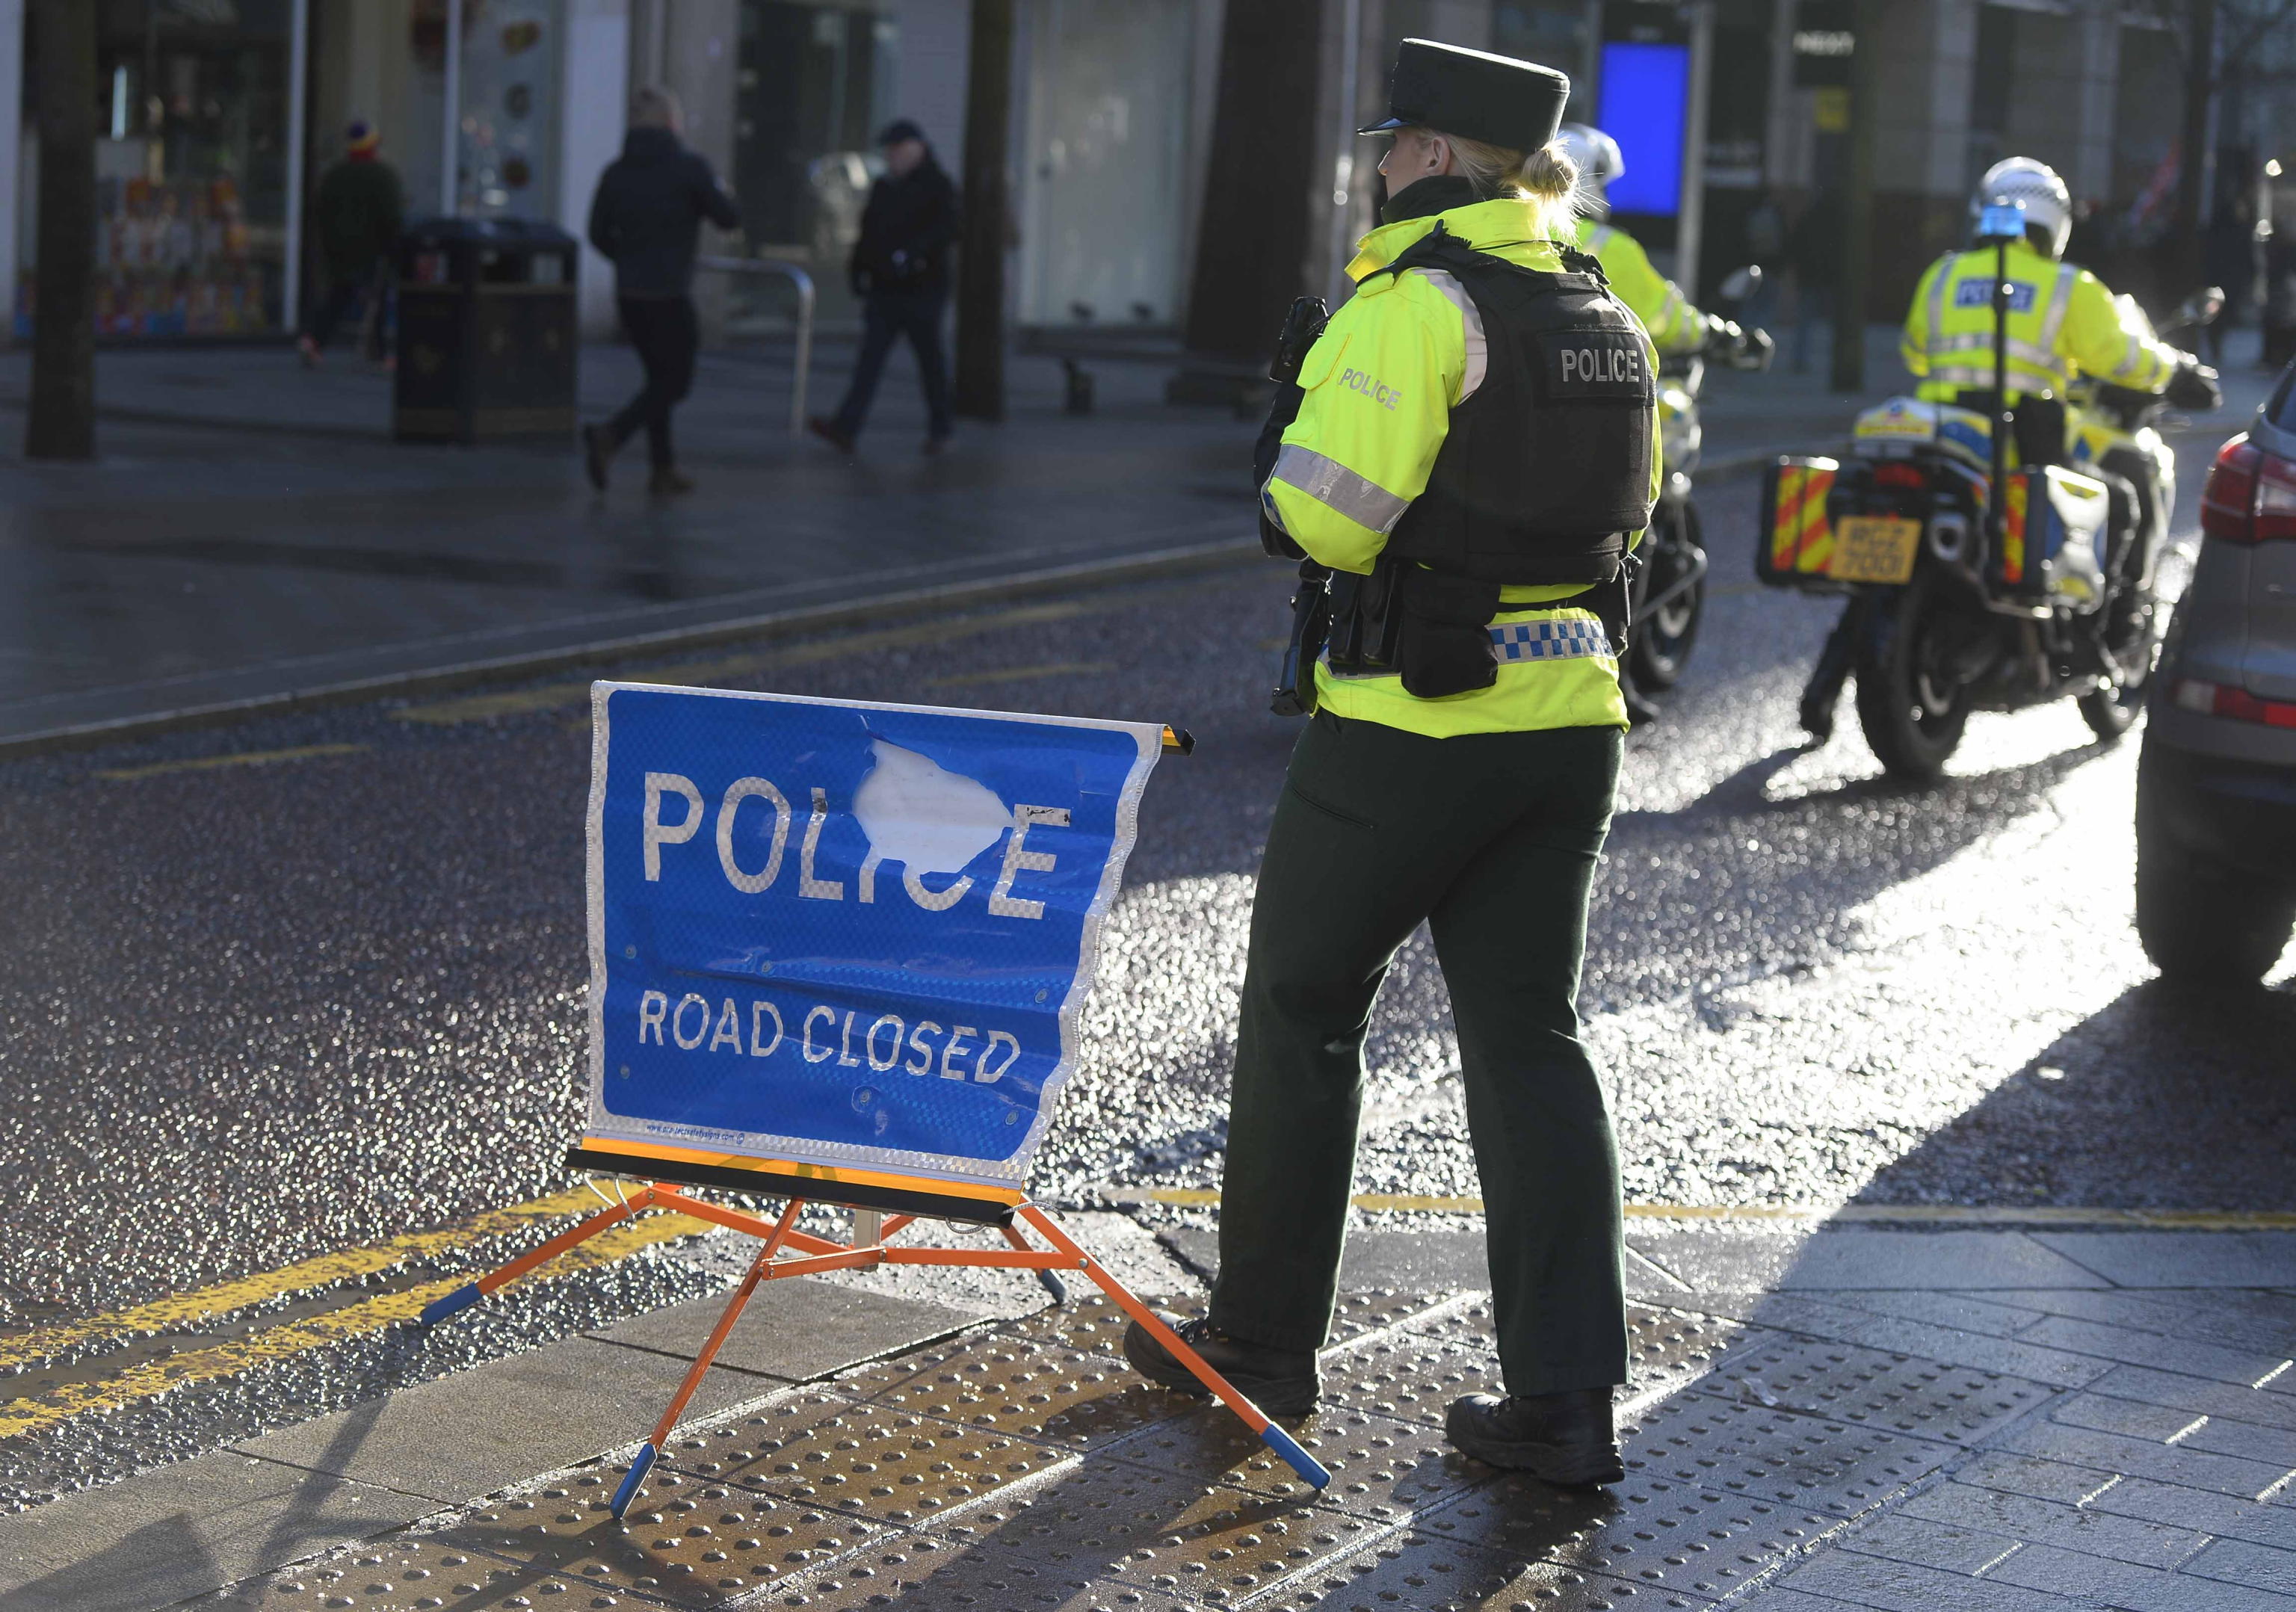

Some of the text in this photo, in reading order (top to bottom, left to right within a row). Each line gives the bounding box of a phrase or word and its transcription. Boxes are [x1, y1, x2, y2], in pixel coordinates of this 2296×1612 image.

[1958, 282, 2031, 311] POLCE
[1561, 349, 1639, 382] POLICE
[1339, 368, 1402, 410] POLICE
[639, 990, 1020, 1083] ROAD CLOSED
